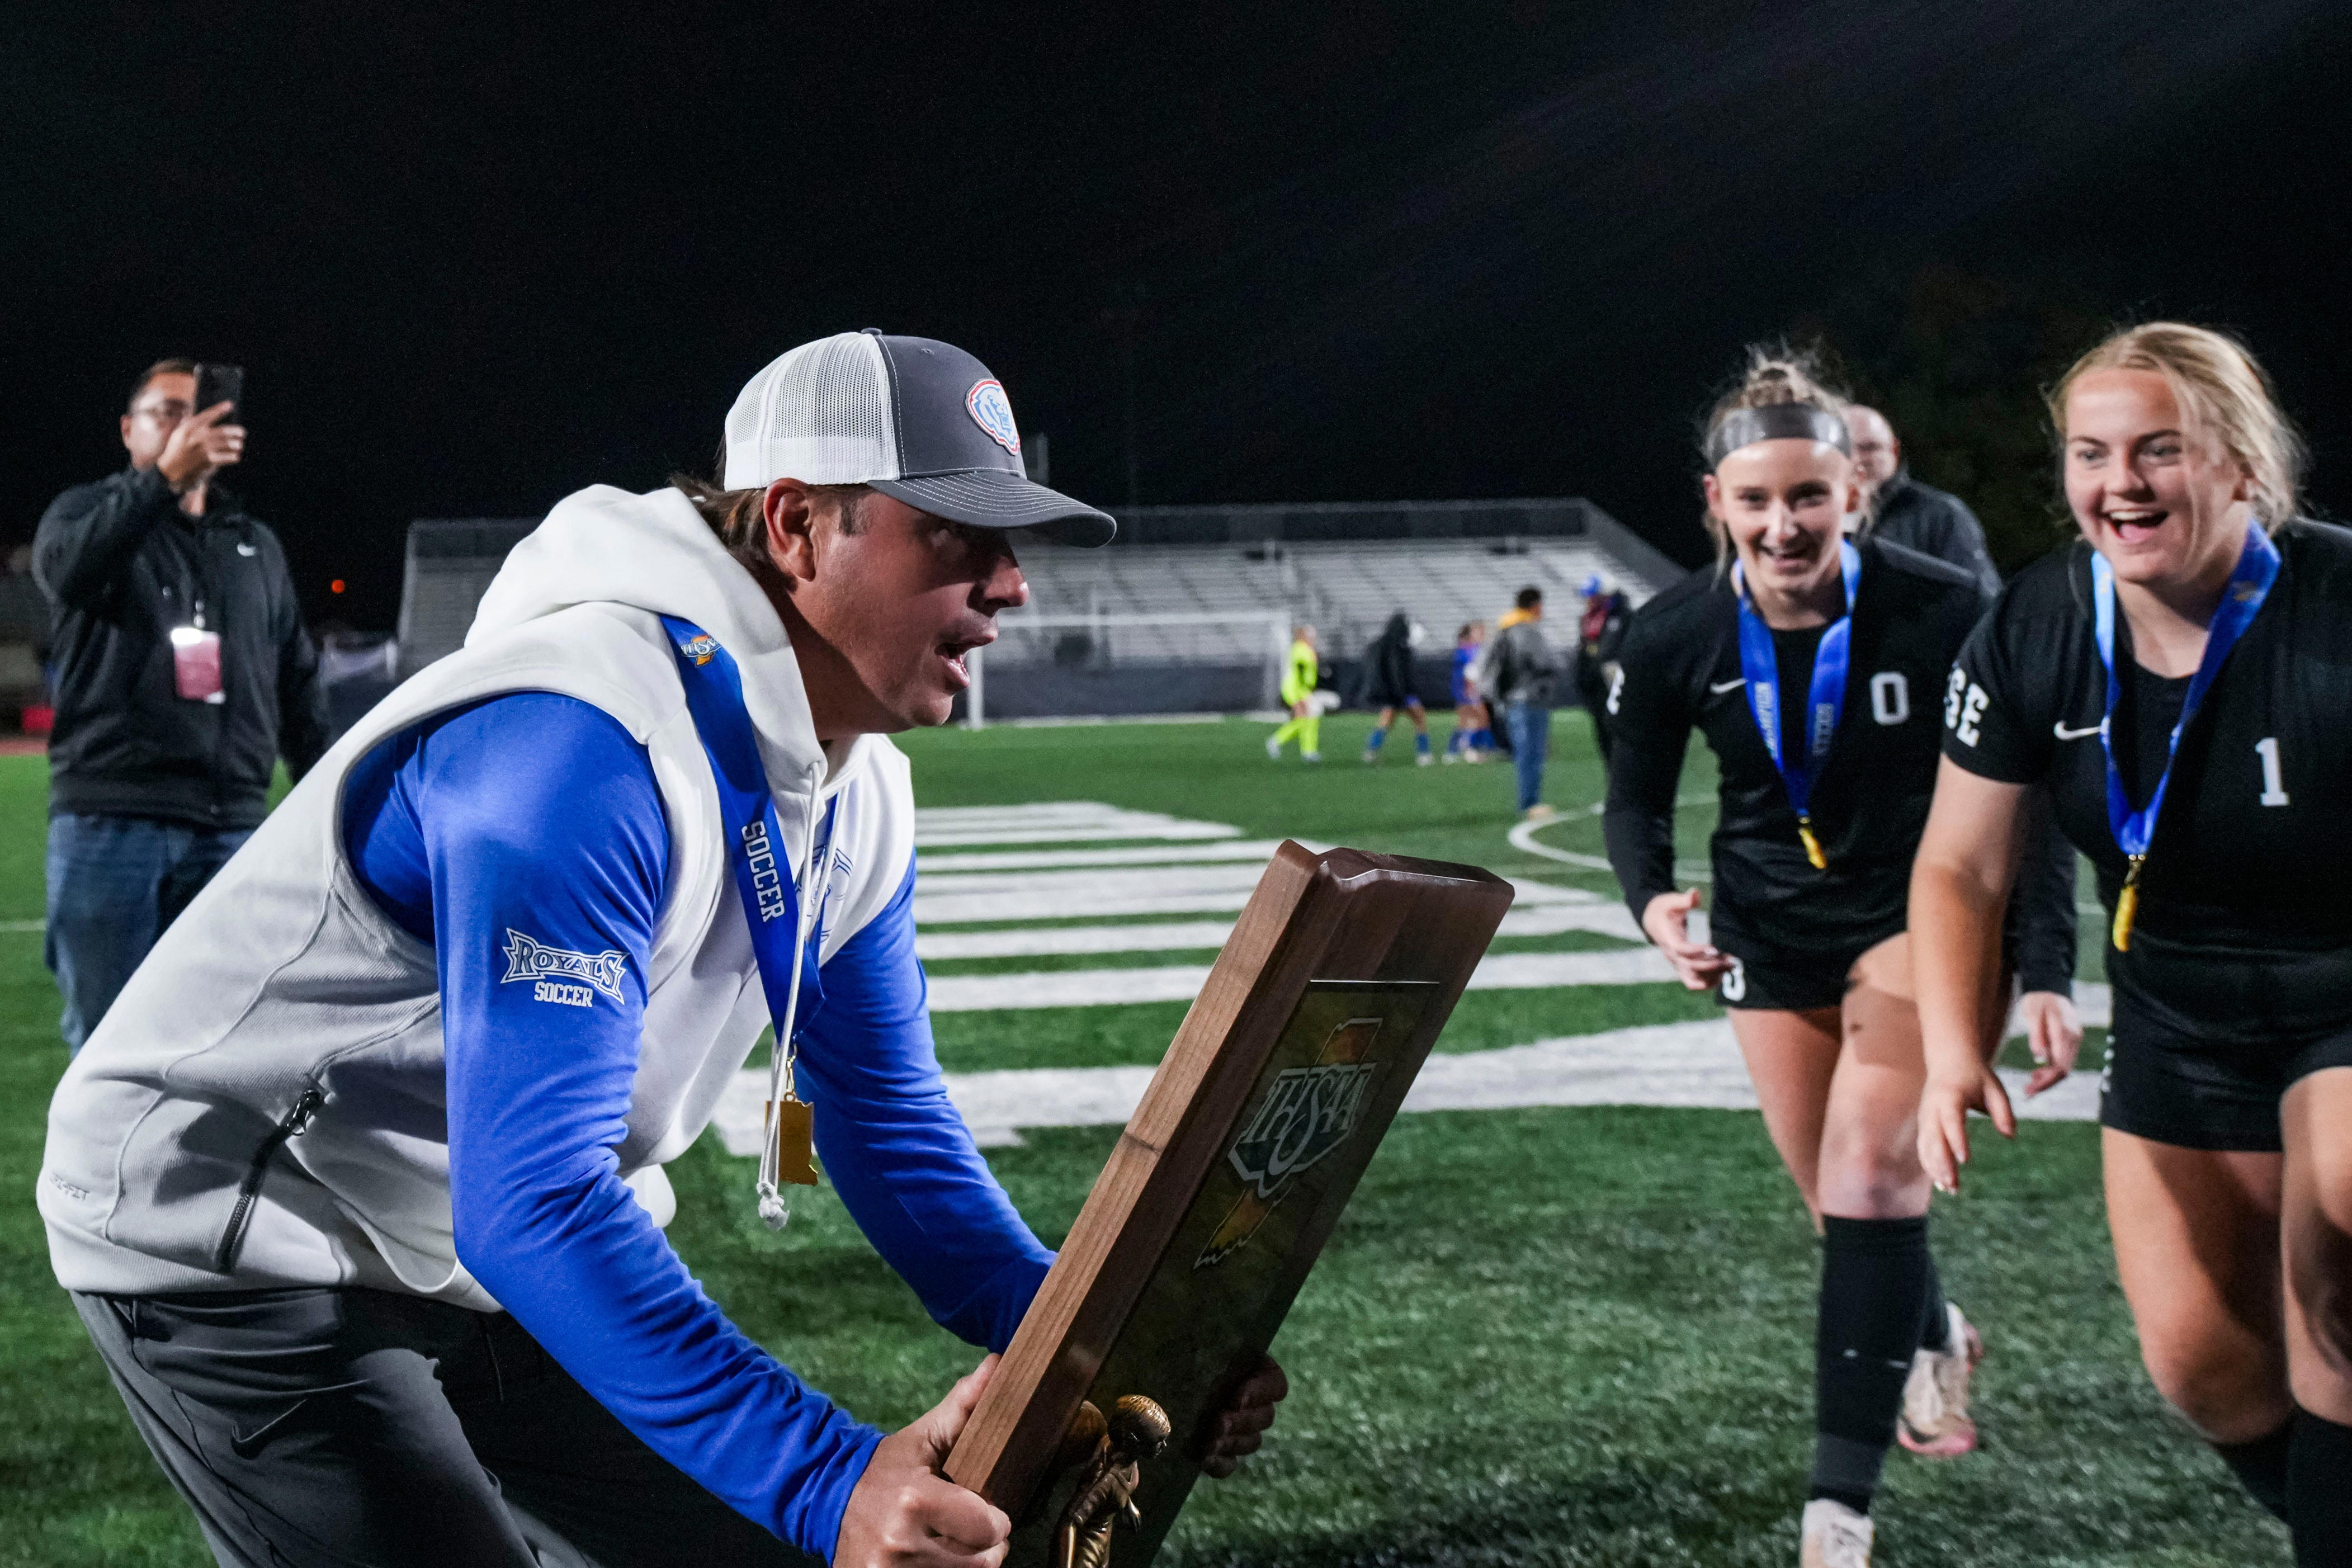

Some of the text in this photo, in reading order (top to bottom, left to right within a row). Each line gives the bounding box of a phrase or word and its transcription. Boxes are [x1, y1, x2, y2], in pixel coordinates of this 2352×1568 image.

[2255, 737, 2290, 806] 1
[741, 820, 785, 923] SOCCER
[508, 935, 622, 988] ROYALS
[533, 981, 594, 1008] SOCCER
[1238, 1070, 1371, 1177] IHSAA
